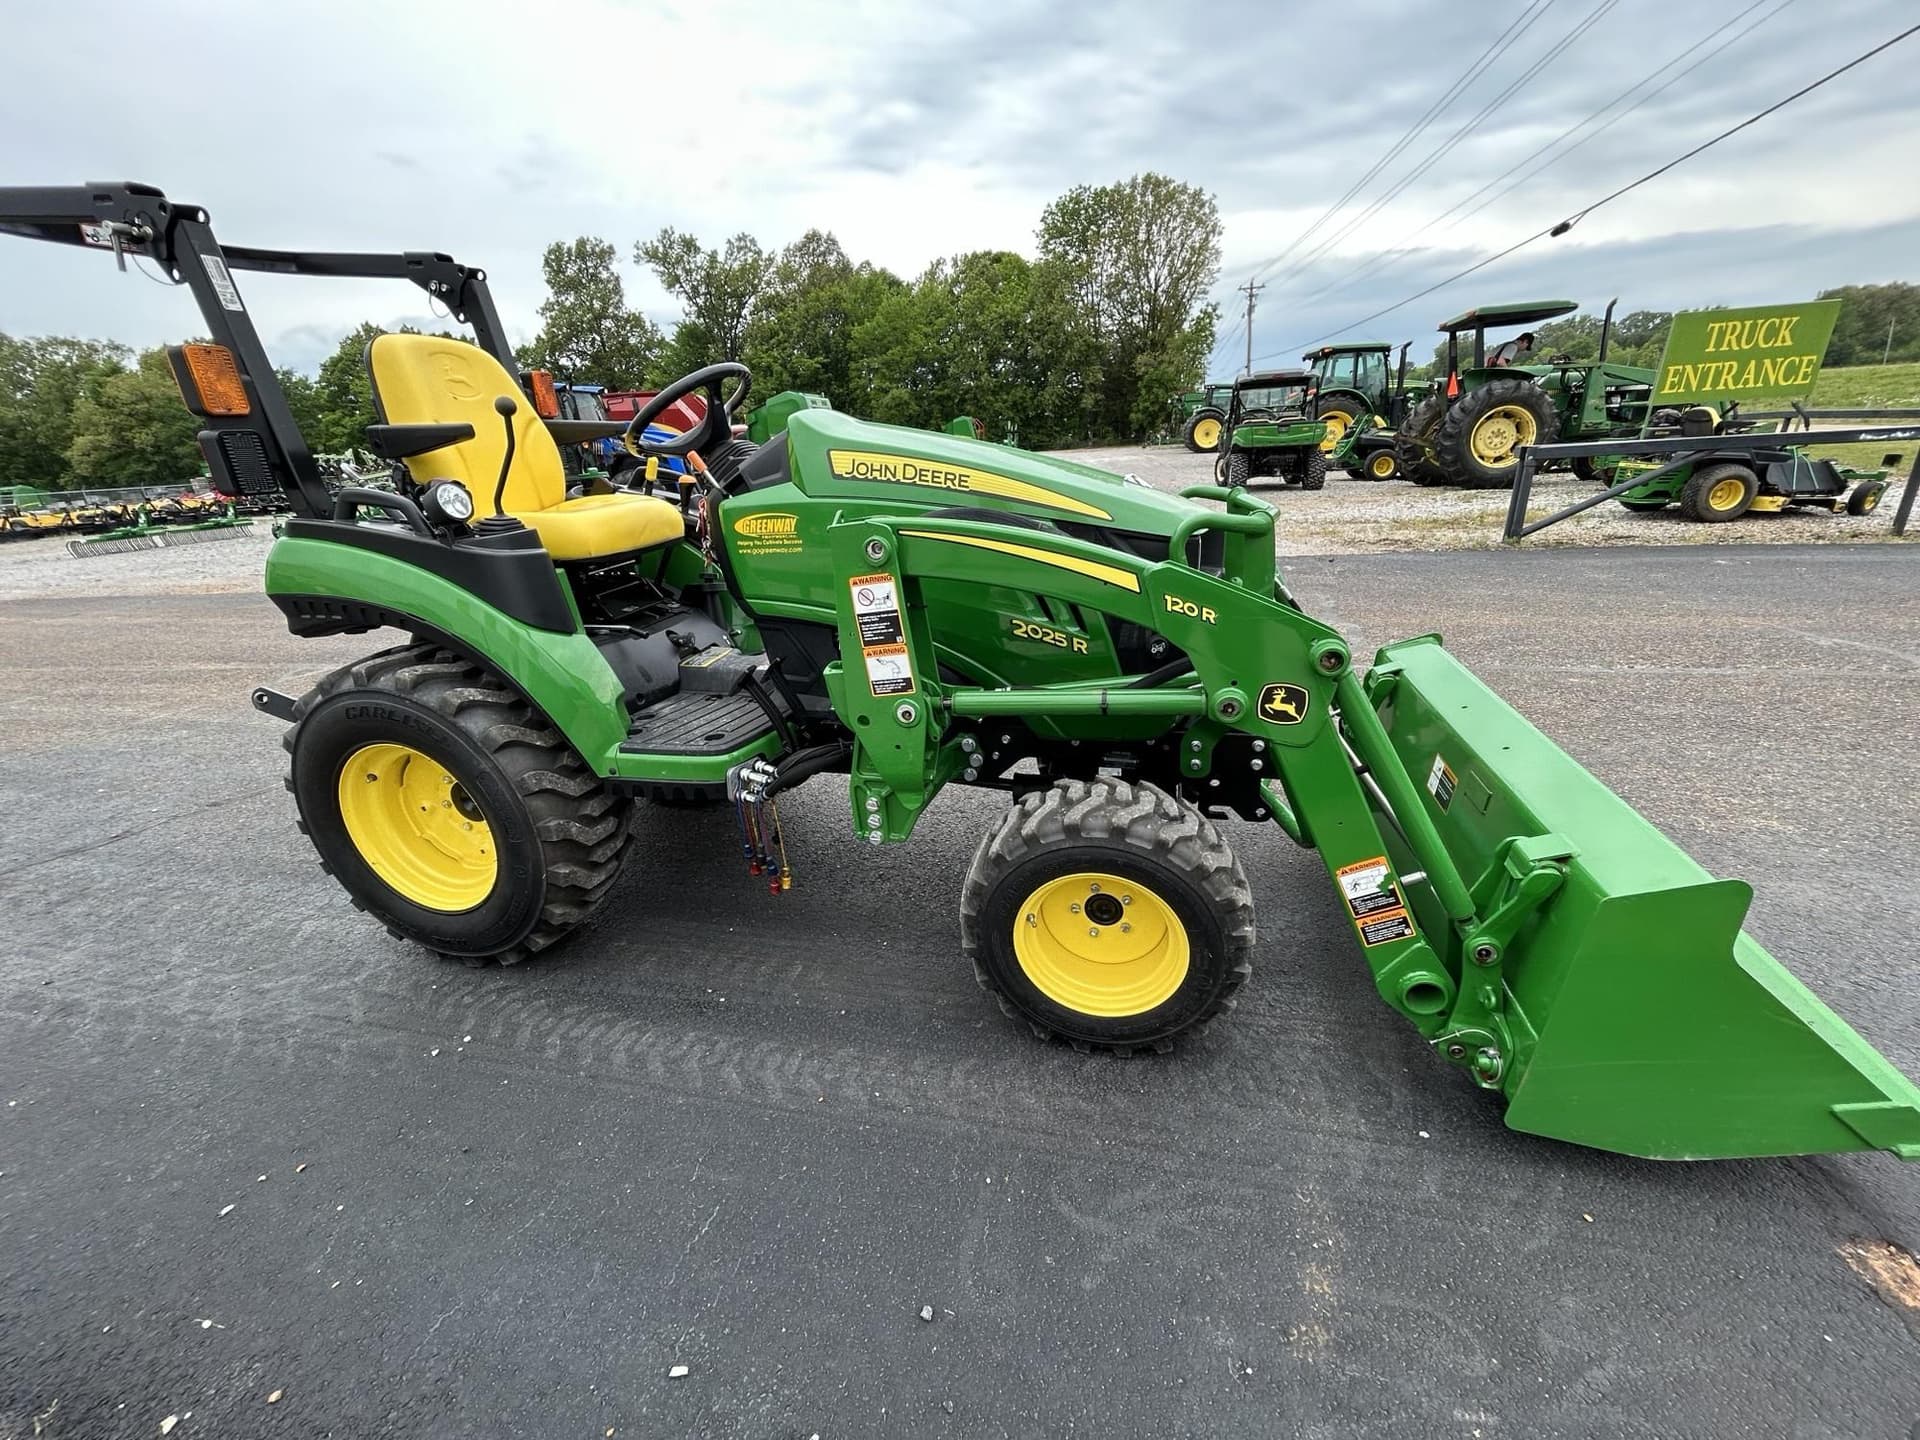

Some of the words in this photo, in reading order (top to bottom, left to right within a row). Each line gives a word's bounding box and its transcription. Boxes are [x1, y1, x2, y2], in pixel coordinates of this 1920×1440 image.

[1705, 316, 1800, 352] TRUCK
[1659, 355, 1817, 394] ENTRANCE
[844, 458, 897, 479] JOHN
[902, 463, 970, 489] DEERE
[743, 518, 797, 533] GREENWAY
[858, 575, 892, 584] WARNING
[1164, 594, 1198, 618] 120
[1202, 607, 1216, 624] R
[1011, 619, 1067, 648] 2025
[1072, 637, 1088, 655] R
[872, 646, 906, 656] WARNING
[1349, 861, 1381, 872] WARNING
[1370, 912, 1402, 923] WARNING
